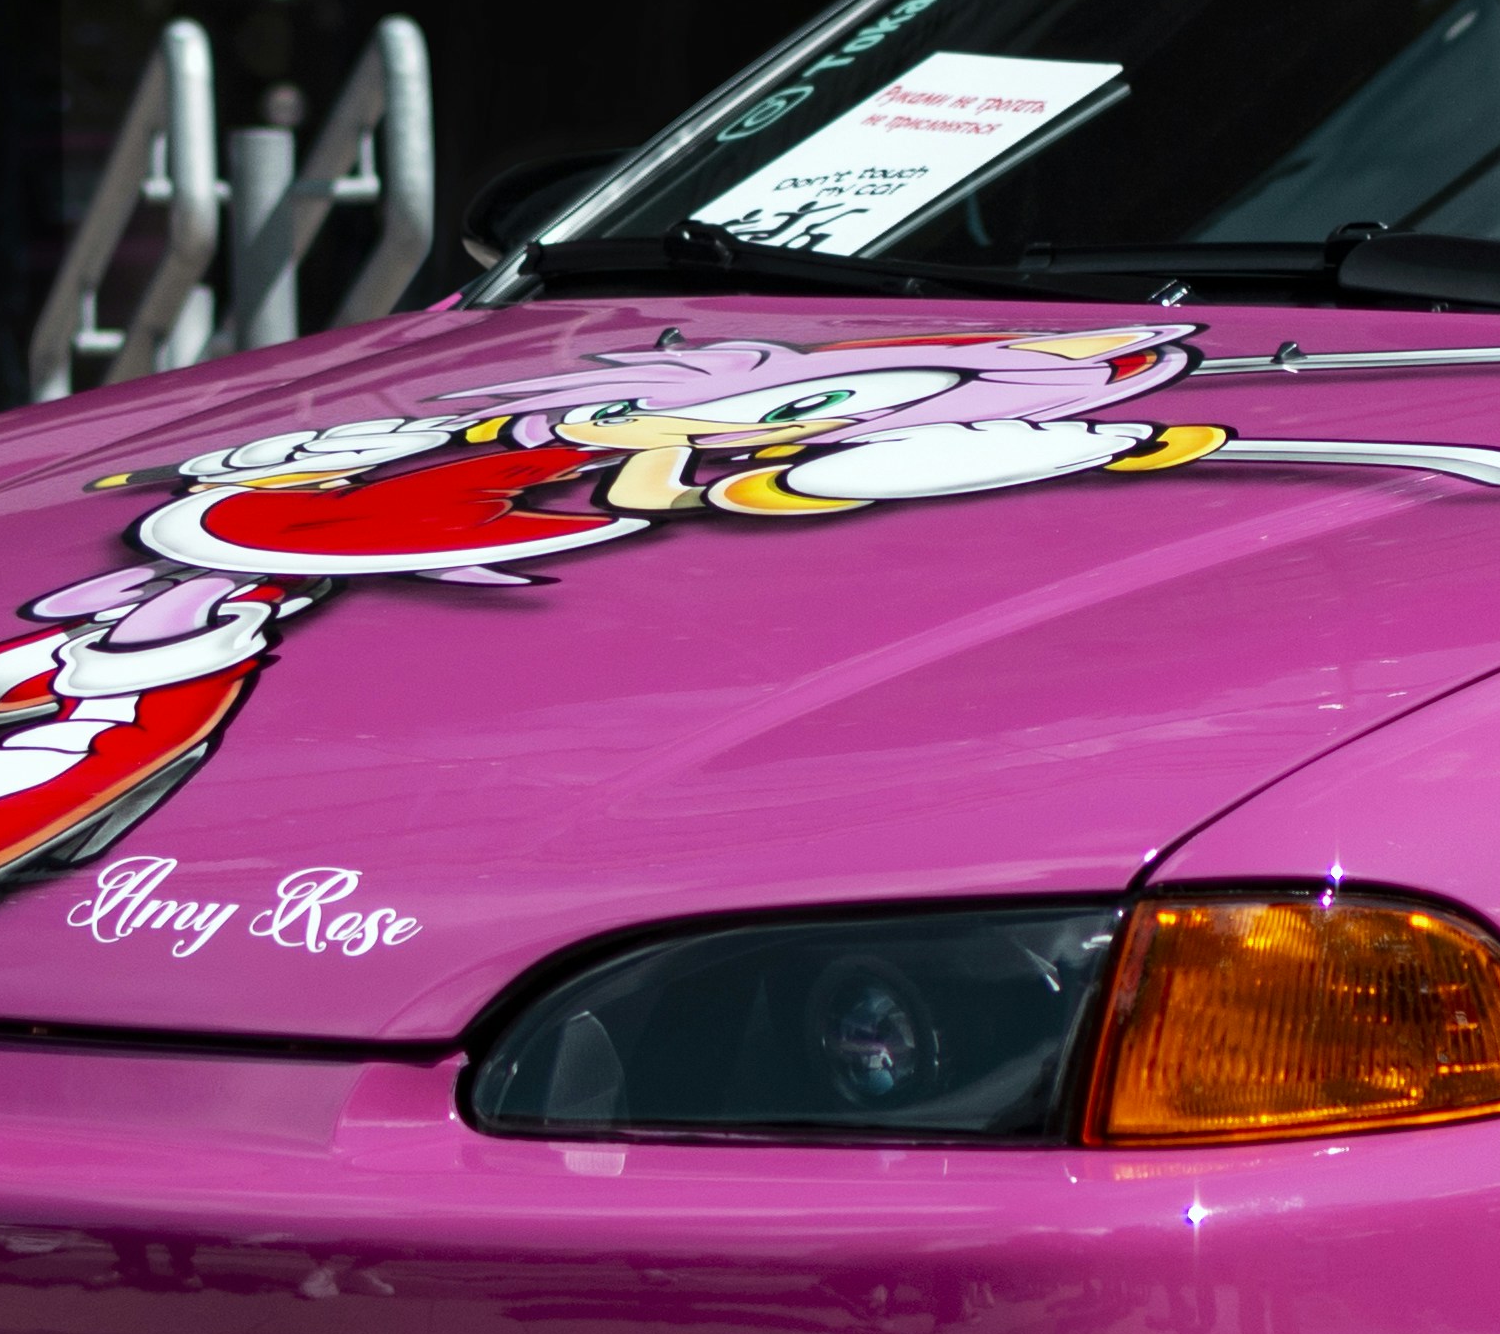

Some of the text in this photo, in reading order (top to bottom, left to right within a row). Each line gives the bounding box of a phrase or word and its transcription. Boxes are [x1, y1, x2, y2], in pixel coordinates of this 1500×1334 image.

[772, 165, 929, 192] Don't touch
[815, 183, 909, 197] my car
[67, 855, 423, 958] Amy Rose
